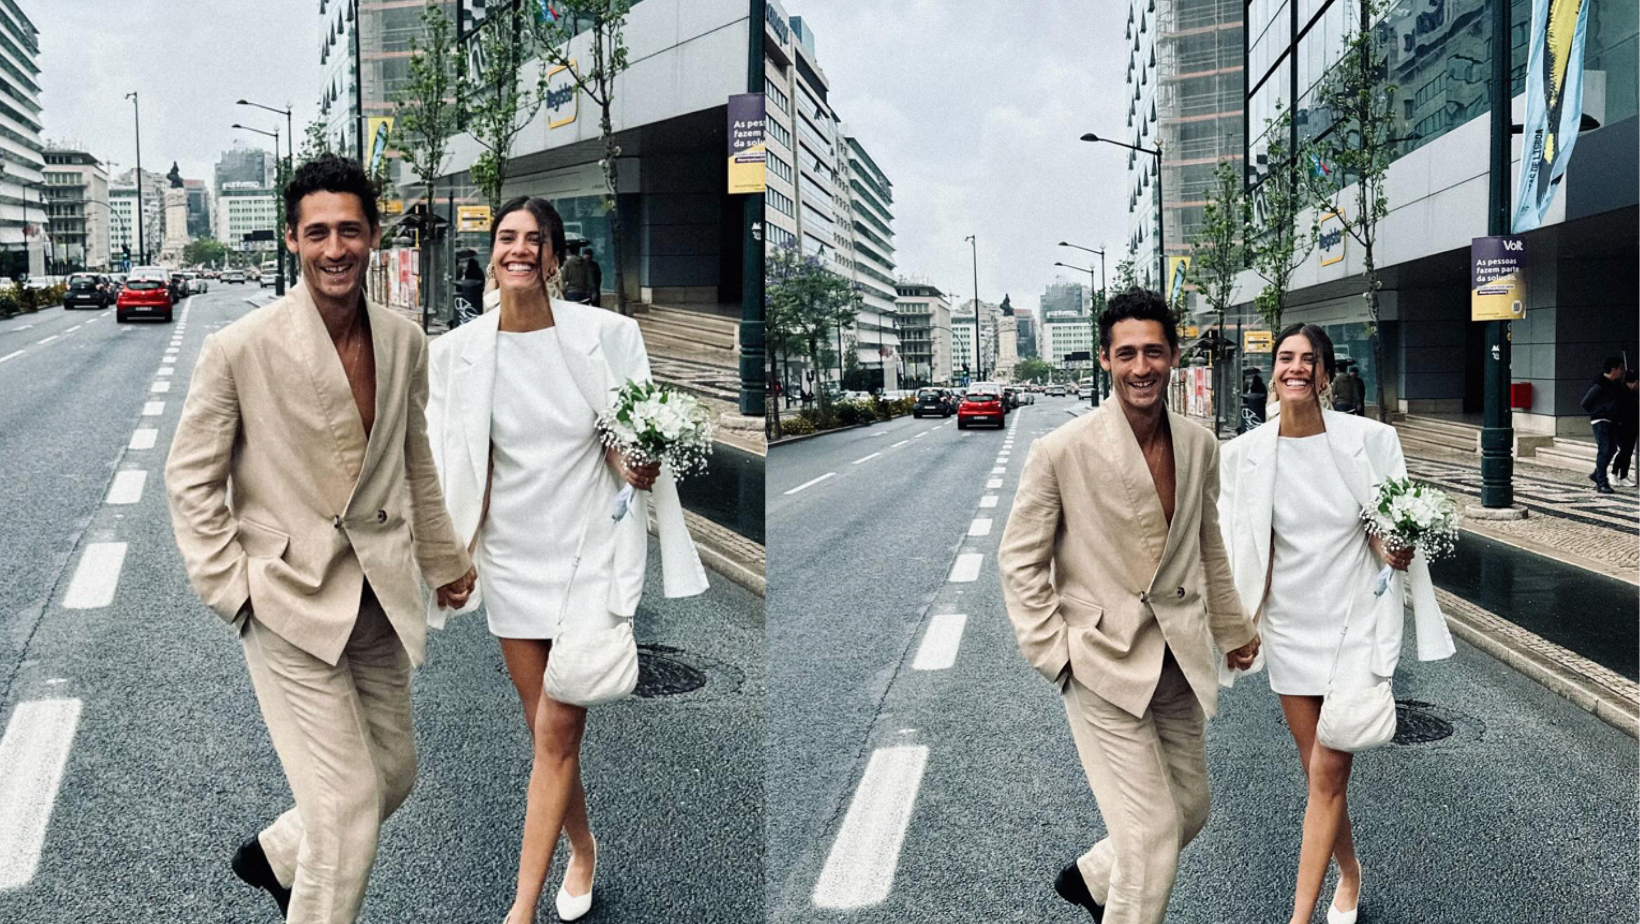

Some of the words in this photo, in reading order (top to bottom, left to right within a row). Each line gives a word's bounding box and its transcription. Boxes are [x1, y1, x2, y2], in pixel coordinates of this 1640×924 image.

[747, 121, 765, 129] pes
[734, 130, 761, 138] fazem
[734, 140, 745, 148] da
[1533, 129, 1544, 160] LISBOA
[1503, 240, 1523, 251] Volt
[1488, 258, 1517, 266] pessoas
[1501, 266, 1519, 274] parte
